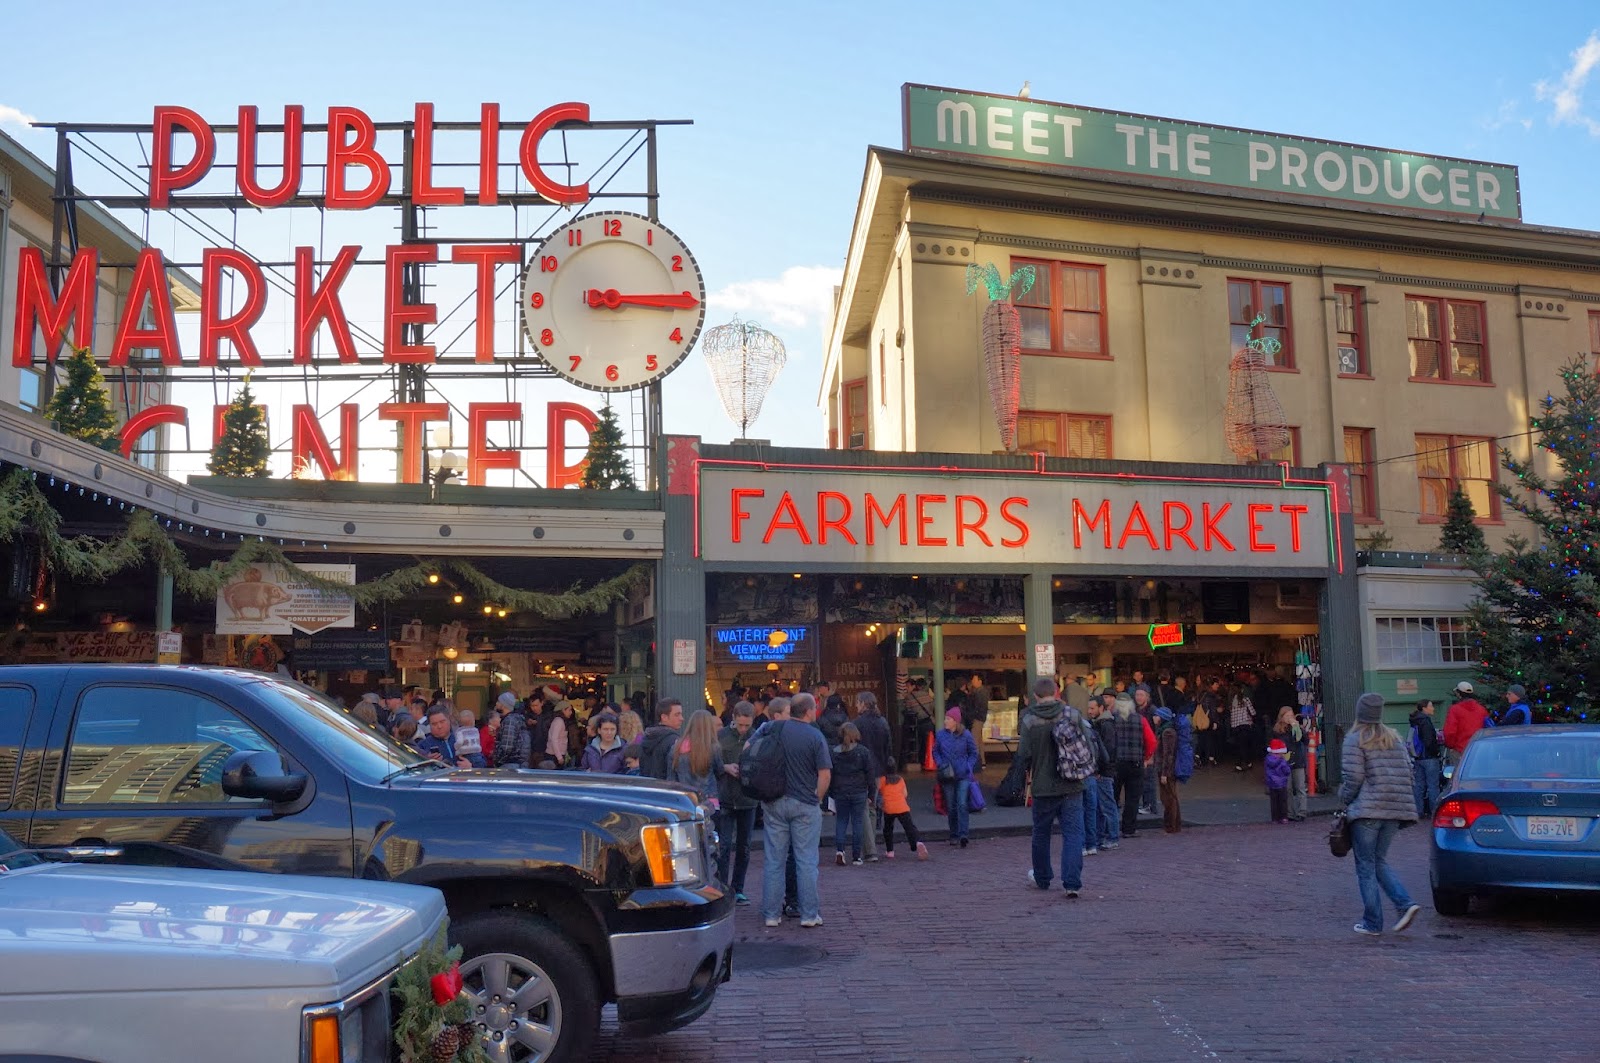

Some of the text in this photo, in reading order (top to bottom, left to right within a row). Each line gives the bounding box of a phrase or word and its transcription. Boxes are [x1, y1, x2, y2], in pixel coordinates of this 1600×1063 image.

[149, 101, 590, 210] PUBLIC
[936, 99, 1501, 211] MEET THE PRODUCER
[604, 219, 622, 236] 12
[568, 229, 582, 246] 11
[647, 229, 653, 246] 1
[541, 256, 558, 272] 10
[672, 255, 683, 272] 2
[12, 245, 522, 368] MARKET
[531, 292, 544, 309] 9
[540, 328, 554, 346] 8
[669, 327, 683, 344] 4
[569, 355, 582, 372] 7
[645, 354, 658, 371] 5
[605, 365, 619, 381] 6
[119, 401, 600, 488] CNTER
[730, 488, 1309, 553] FARMERS MARKET
[717, 628, 806, 643] WATERFNT
[836, 662, 869, 676] LOWER
